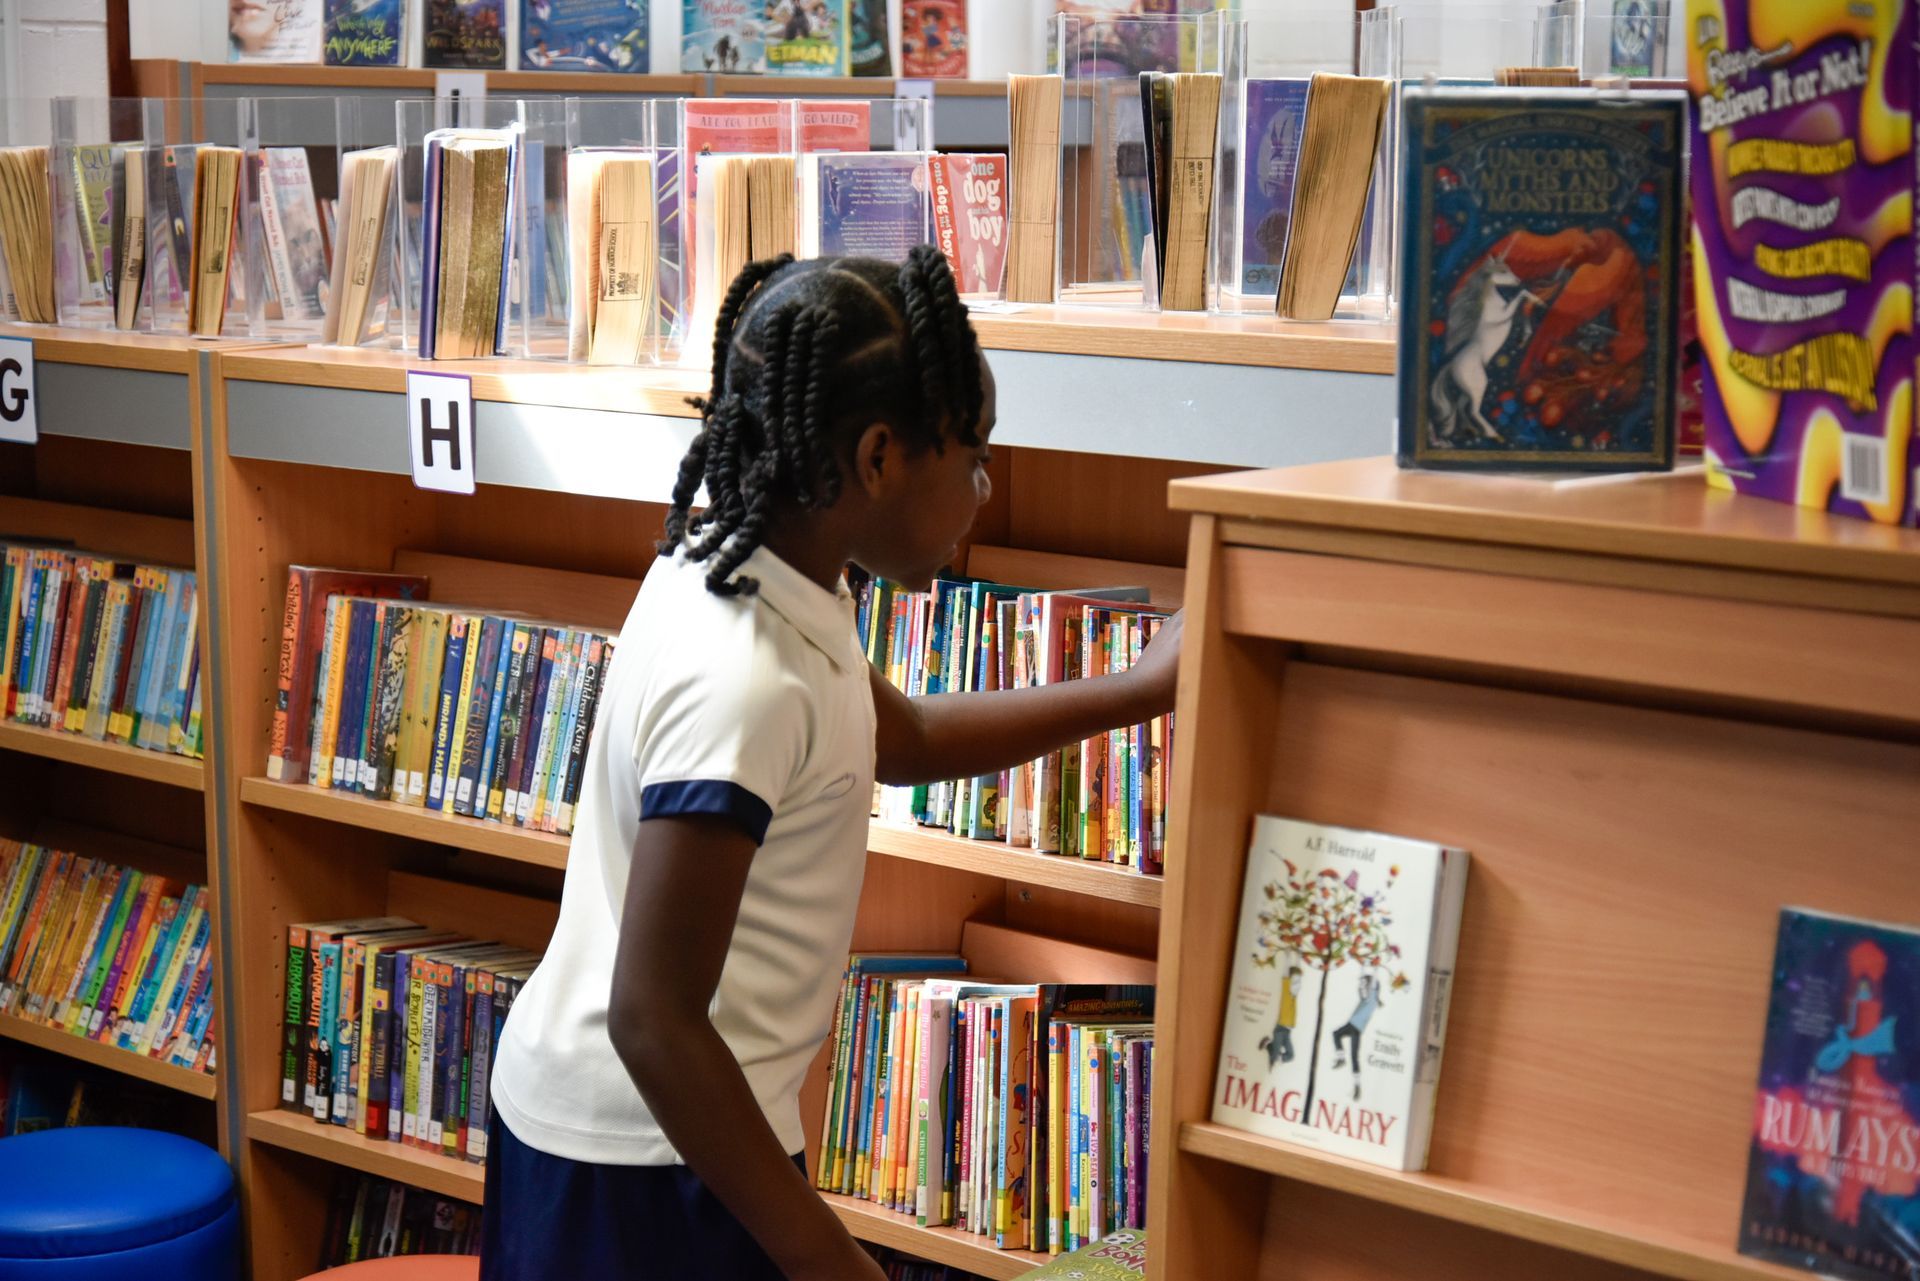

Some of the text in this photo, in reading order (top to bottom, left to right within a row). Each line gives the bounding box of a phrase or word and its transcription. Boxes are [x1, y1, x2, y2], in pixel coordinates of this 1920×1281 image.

[1700, 85, 1769, 133] Believe
[1771, 69, 1793, 109] It
[1793, 69, 1820, 102] or
[971, 161, 995, 176] one
[1481, 169, 1619, 191] MYTHS AND
[1486, 149, 1608, 170] UNICORNS
[933, 161, 950, 215] one dog
[963, 171, 1001, 212] dog
[1487, 192, 1610, 214] MONSTERS
[941, 228, 954, 258] boy
[966, 208, 1004, 247] boy
[0, 357, 29, 422] G
[420, 397, 462, 471] H
[278, 581, 301, 683] Shadow Forest
[436, 693, 452, 747] MIRANDA
[461, 698, 484, 767] CURSES
[570, 664, 596, 755] Children King
[1328, 840, 1377, 863] Harrold
[285, 947, 304, 1024] DARKMOUTH
[306, 951, 324, 1026] DARKMOUTH
[1225, 1054, 1249, 1072] The
[1367, 1054, 1406, 1074] Gravett
[1373, 1039, 1401, 1059] Emily
[918, 1059, 927, 1088] Family
[872, 1111, 884, 1170] CHRIS HIGGINS
[1759, 1092, 1920, 1175] RUMAYS
